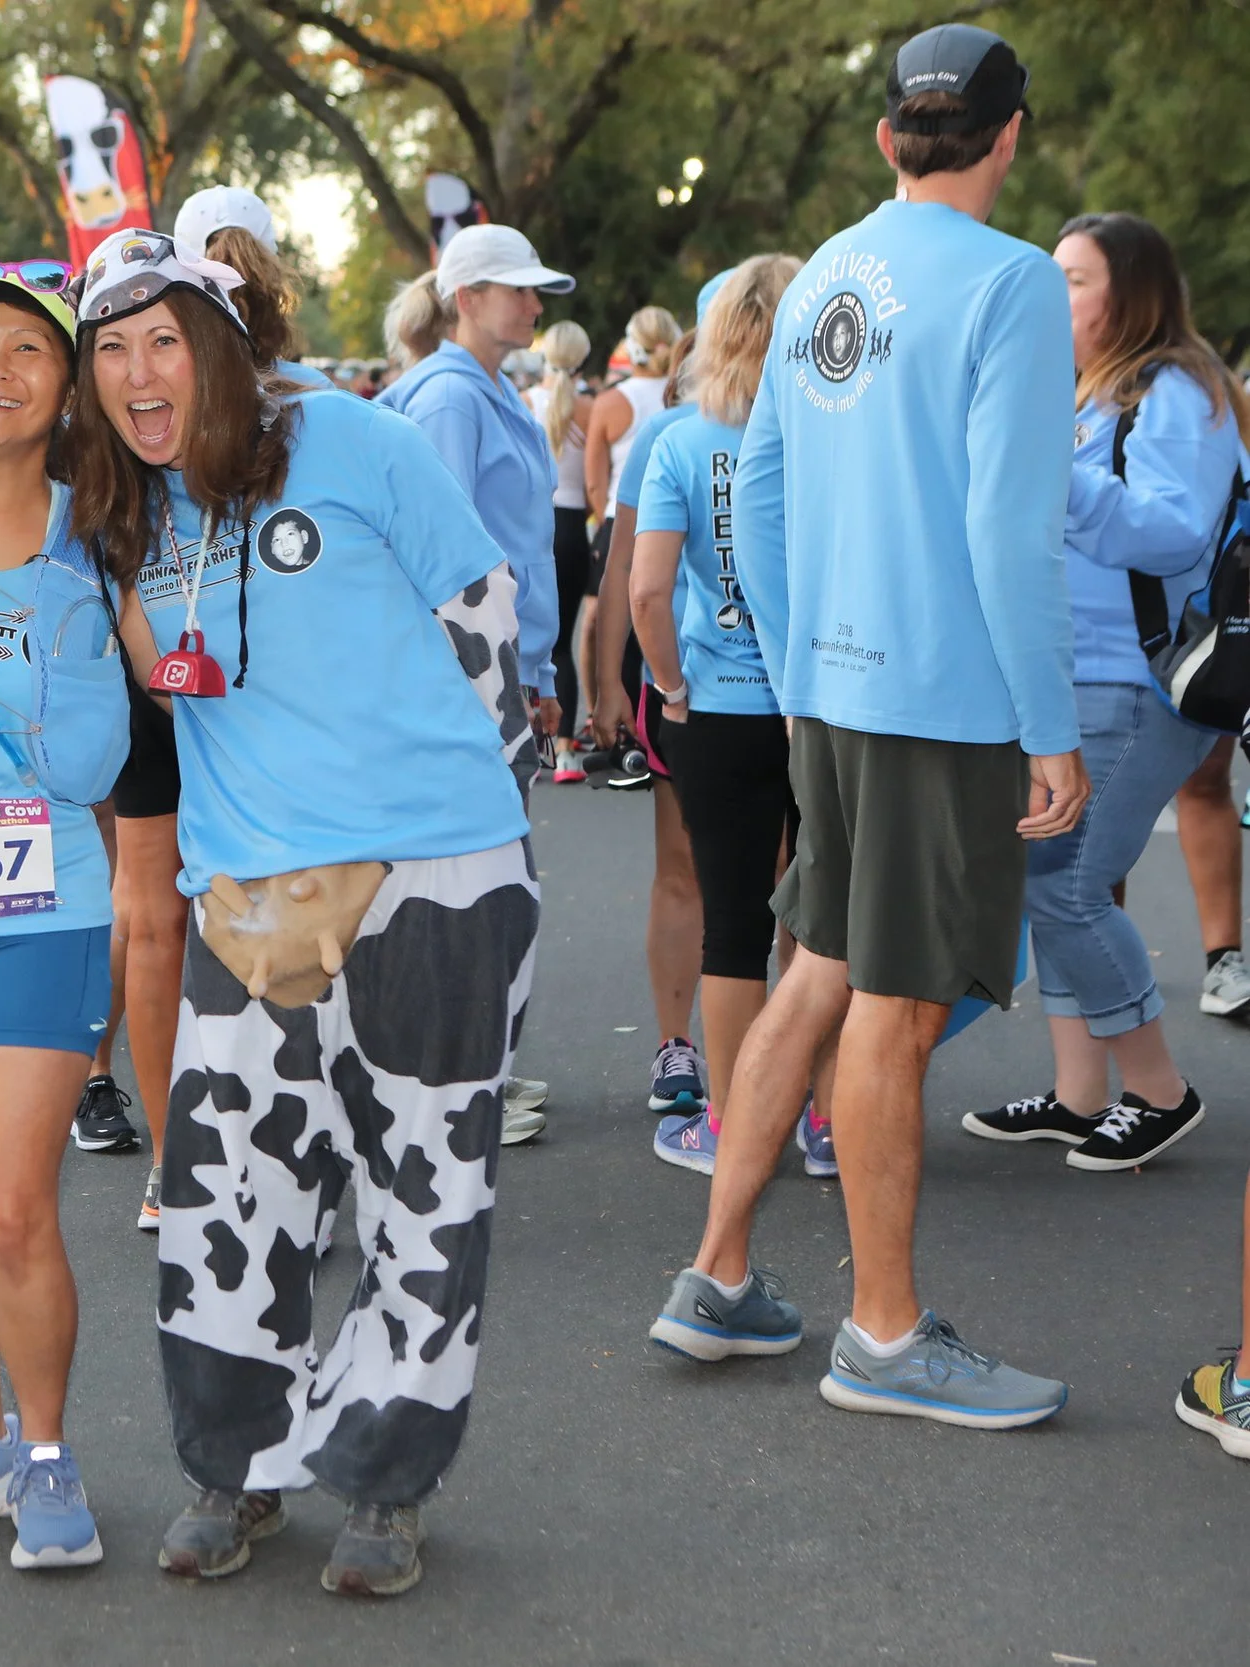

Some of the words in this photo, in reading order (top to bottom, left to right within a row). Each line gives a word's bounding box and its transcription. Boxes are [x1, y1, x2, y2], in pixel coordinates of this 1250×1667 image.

[793, 244, 907, 323] motivated
[842, 294, 856, 309] FOR
[795, 367, 807, 388] to
[804, 384, 833, 413] move
[836, 395, 856, 413] into
[856, 371, 874, 398] life
[138, 564, 179, 583] UNNIN
[187, 557, 210, 573] FR
[156, 582, 174, 592] into
[176, 578, 193, 588] lie
[837, 623, 853, 637] 2018
[717, 675, 769, 684] www.run
[4, 805, 42, 816] Cow
